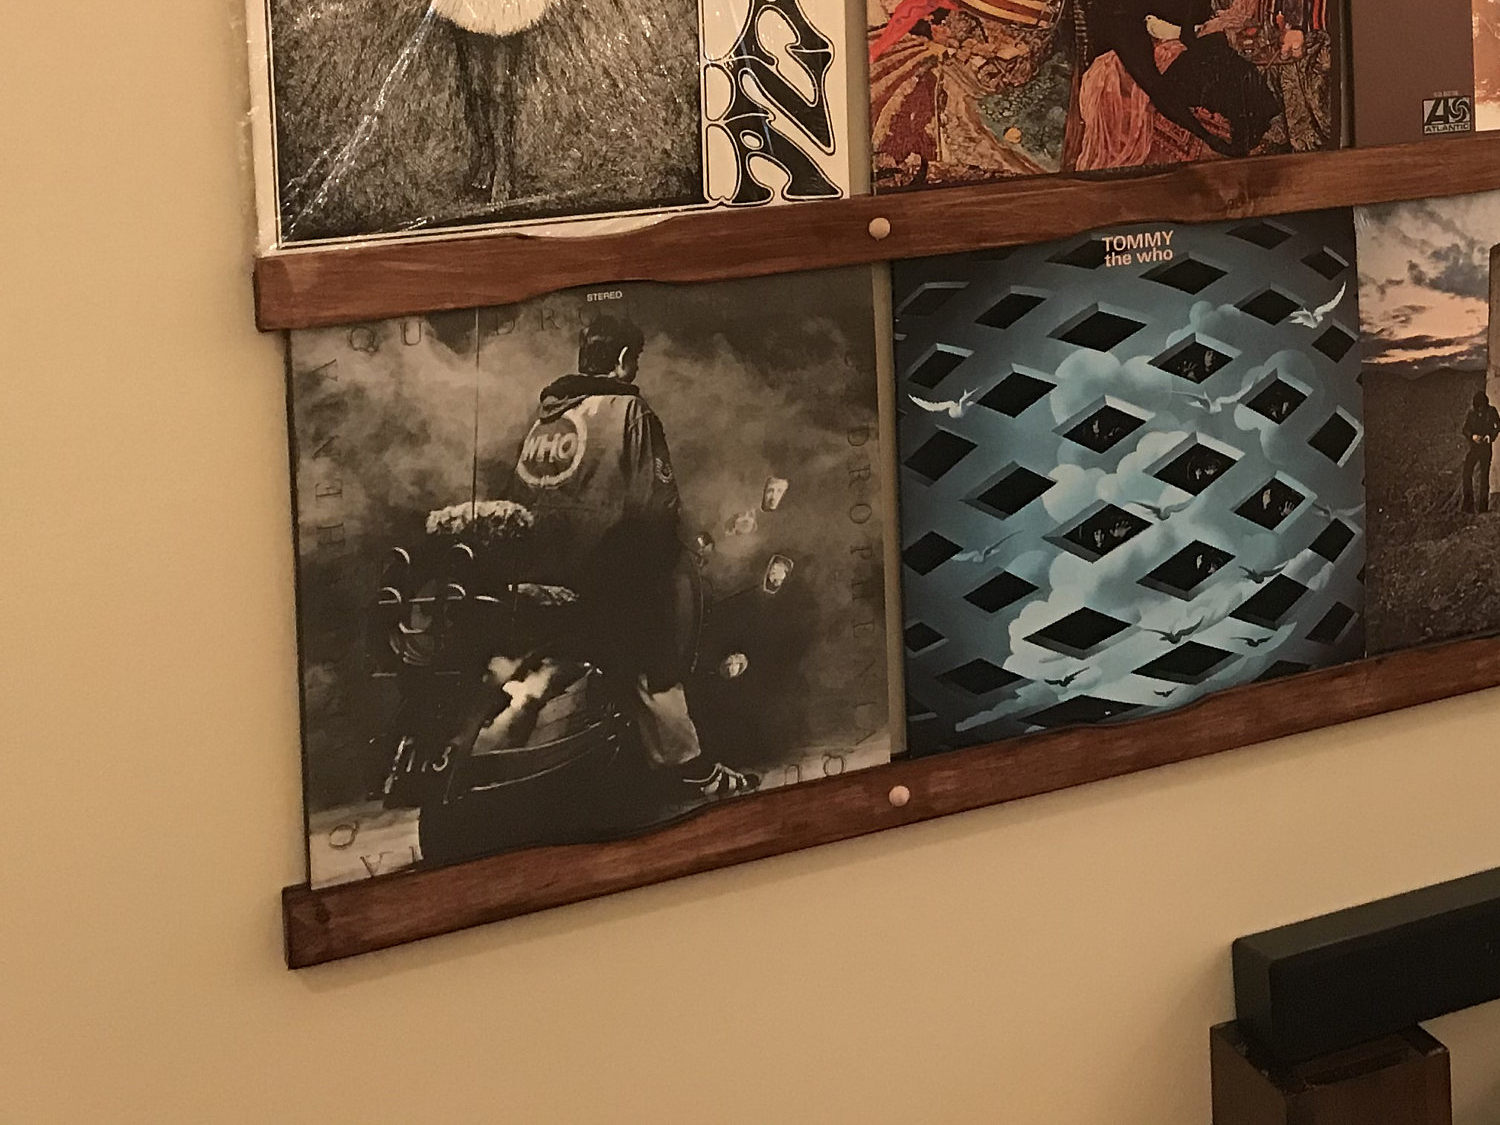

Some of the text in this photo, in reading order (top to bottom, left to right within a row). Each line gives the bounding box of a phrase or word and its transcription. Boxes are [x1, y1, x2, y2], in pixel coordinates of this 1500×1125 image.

[1425, 123, 1470, 133] ATLANTIC
[1101, 229, 1174, 252] TOMMY
[1104, 247, 1174, 267] the who
[586, 290, 623, 302] STEREO
[520, 432, 579, 463] WHO
